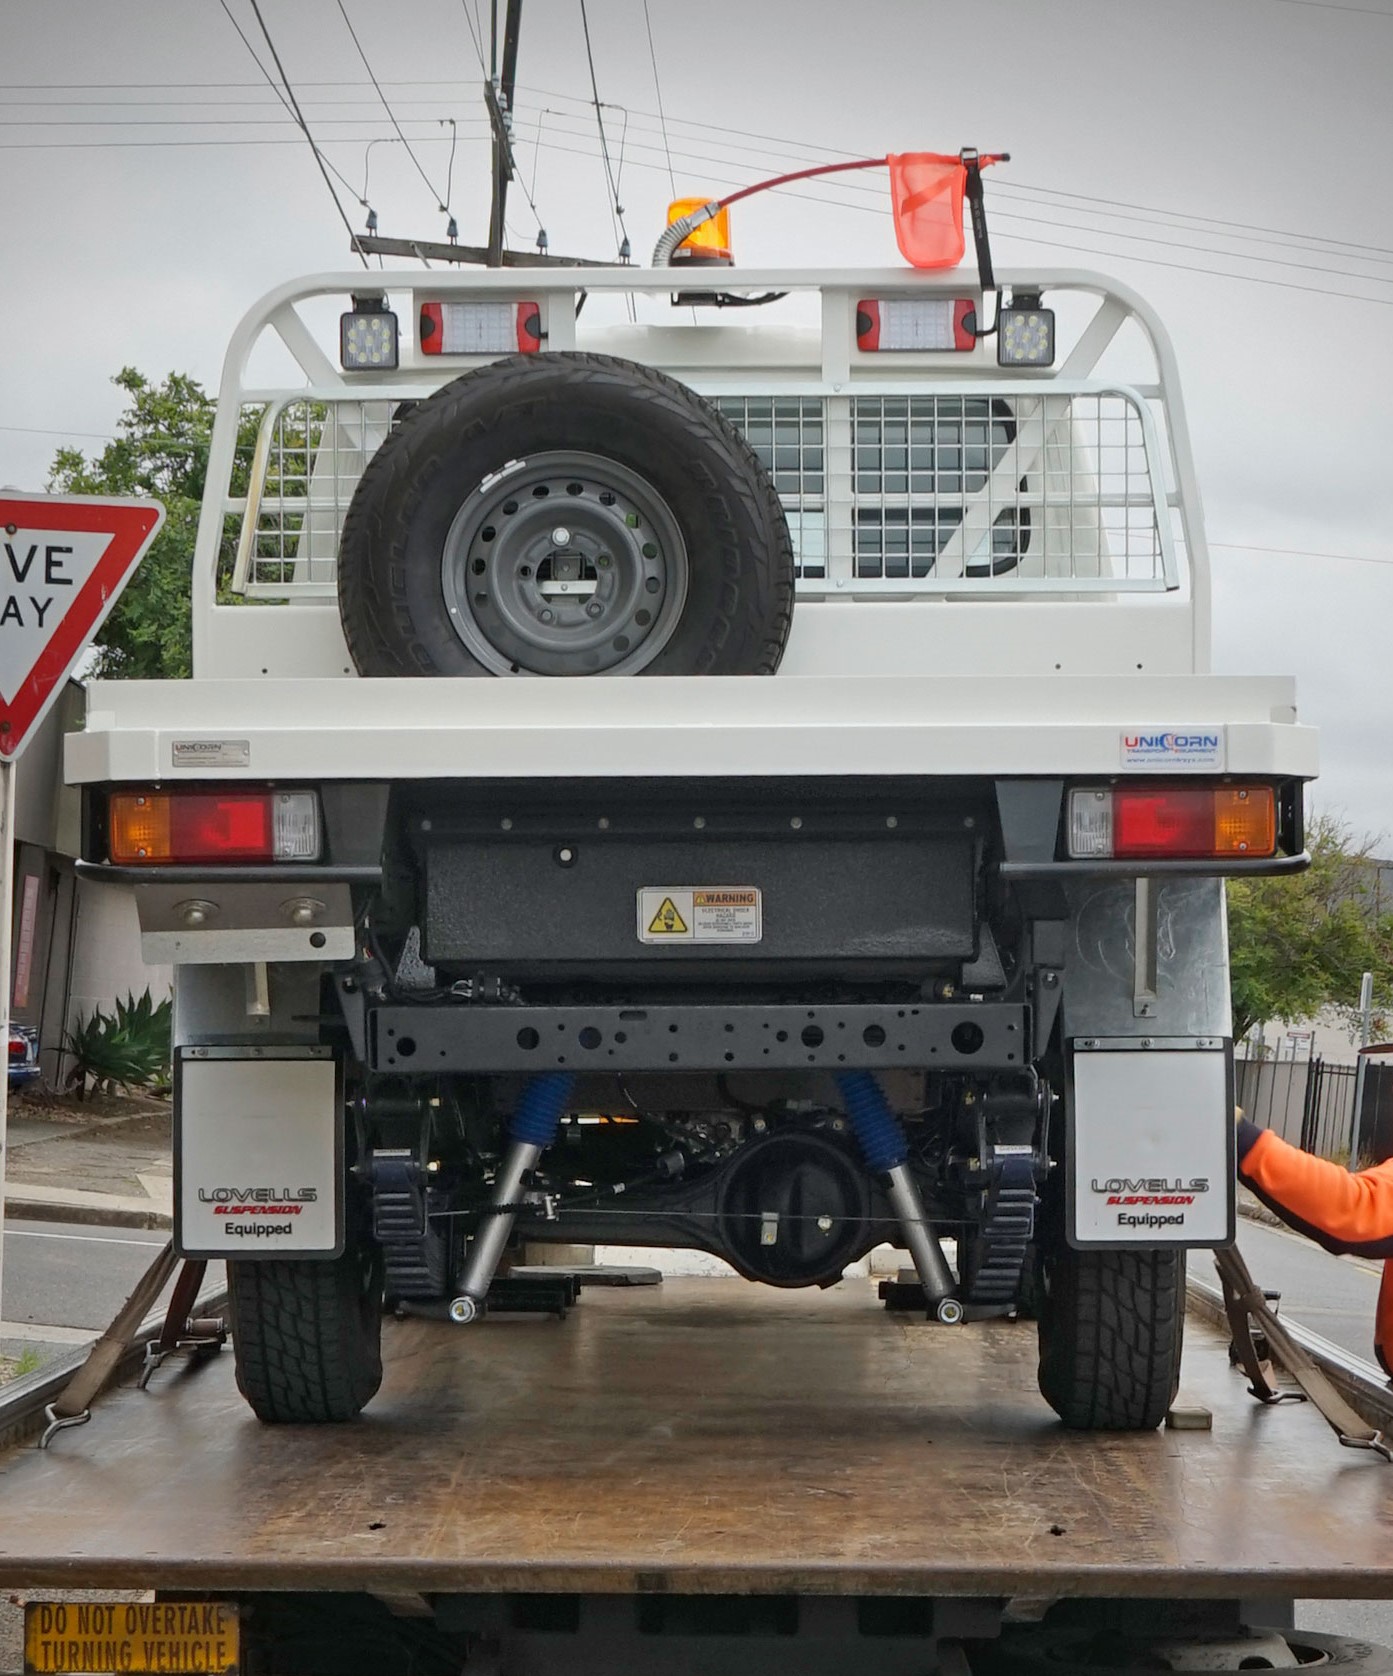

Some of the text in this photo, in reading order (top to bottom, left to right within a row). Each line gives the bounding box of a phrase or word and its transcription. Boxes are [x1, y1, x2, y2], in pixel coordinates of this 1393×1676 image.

[1124, 733, 1218, 749] UNICORN
[705, 893, 754, 904] WARNING
[1091, 1178, 1210, 1193] LOVELLS
[198, 1187, 318, 1203] LOVELLS
[1106, 1196, 1196, 1205] SUSPENSION
[213, 1205, 303, 1215] SUSPENSION
[1117, 1213, 1185, 1228] Equipped
[224, 1222, 293, 1237] Equipped
[40, 1605, 226, 1635] DO NOT OVERTAKE
[41, 1640, 227, 1671] TURNING VEHICLE
